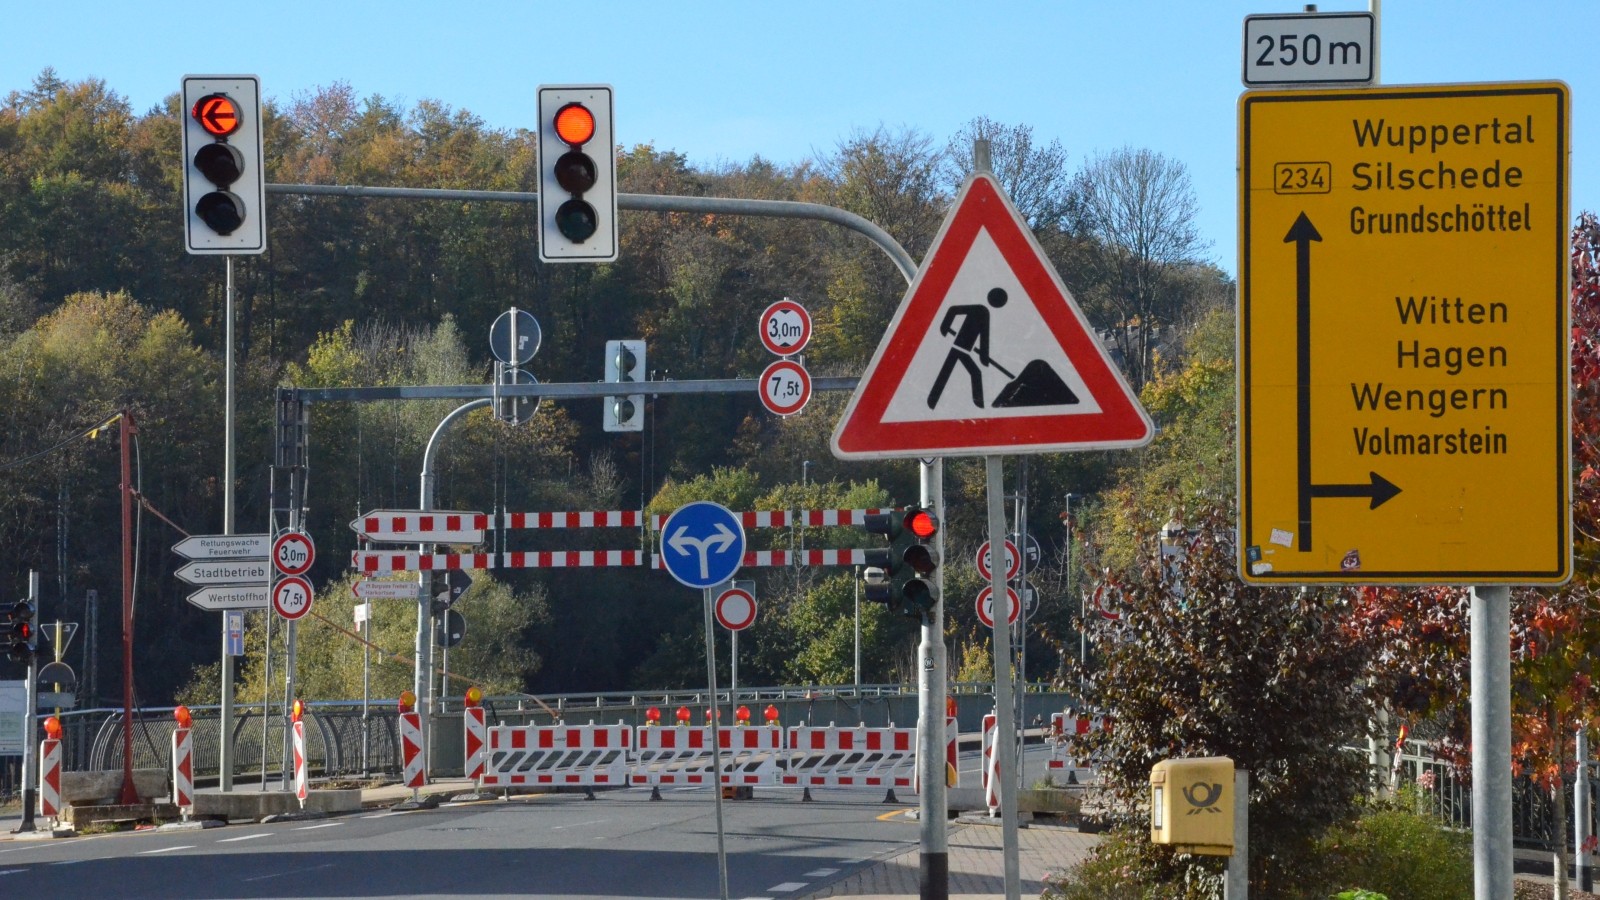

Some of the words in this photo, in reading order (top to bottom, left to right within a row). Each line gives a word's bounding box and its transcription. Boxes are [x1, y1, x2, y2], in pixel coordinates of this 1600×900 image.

[1352, 115, 1535, 154] Wuppertal
[1280, 167, 1325, 189] 234
[1351, 159, 1523, 191] Silschede
[1350, 202, 1532, 235] Grundschöttel
[1395, 296, 1508, 325] Witten
[1397, 340, 1508, 375] Hagen
[1351, 382, 1508, 417] Wengern
[1353, 426, 1508, 455] Volmarstein
[200, 540, 259, 548] Rettungswache
[194, 568, 264, 578] Stadtbetrieb
[208, 592, 268, 603] Wertstoffhof
